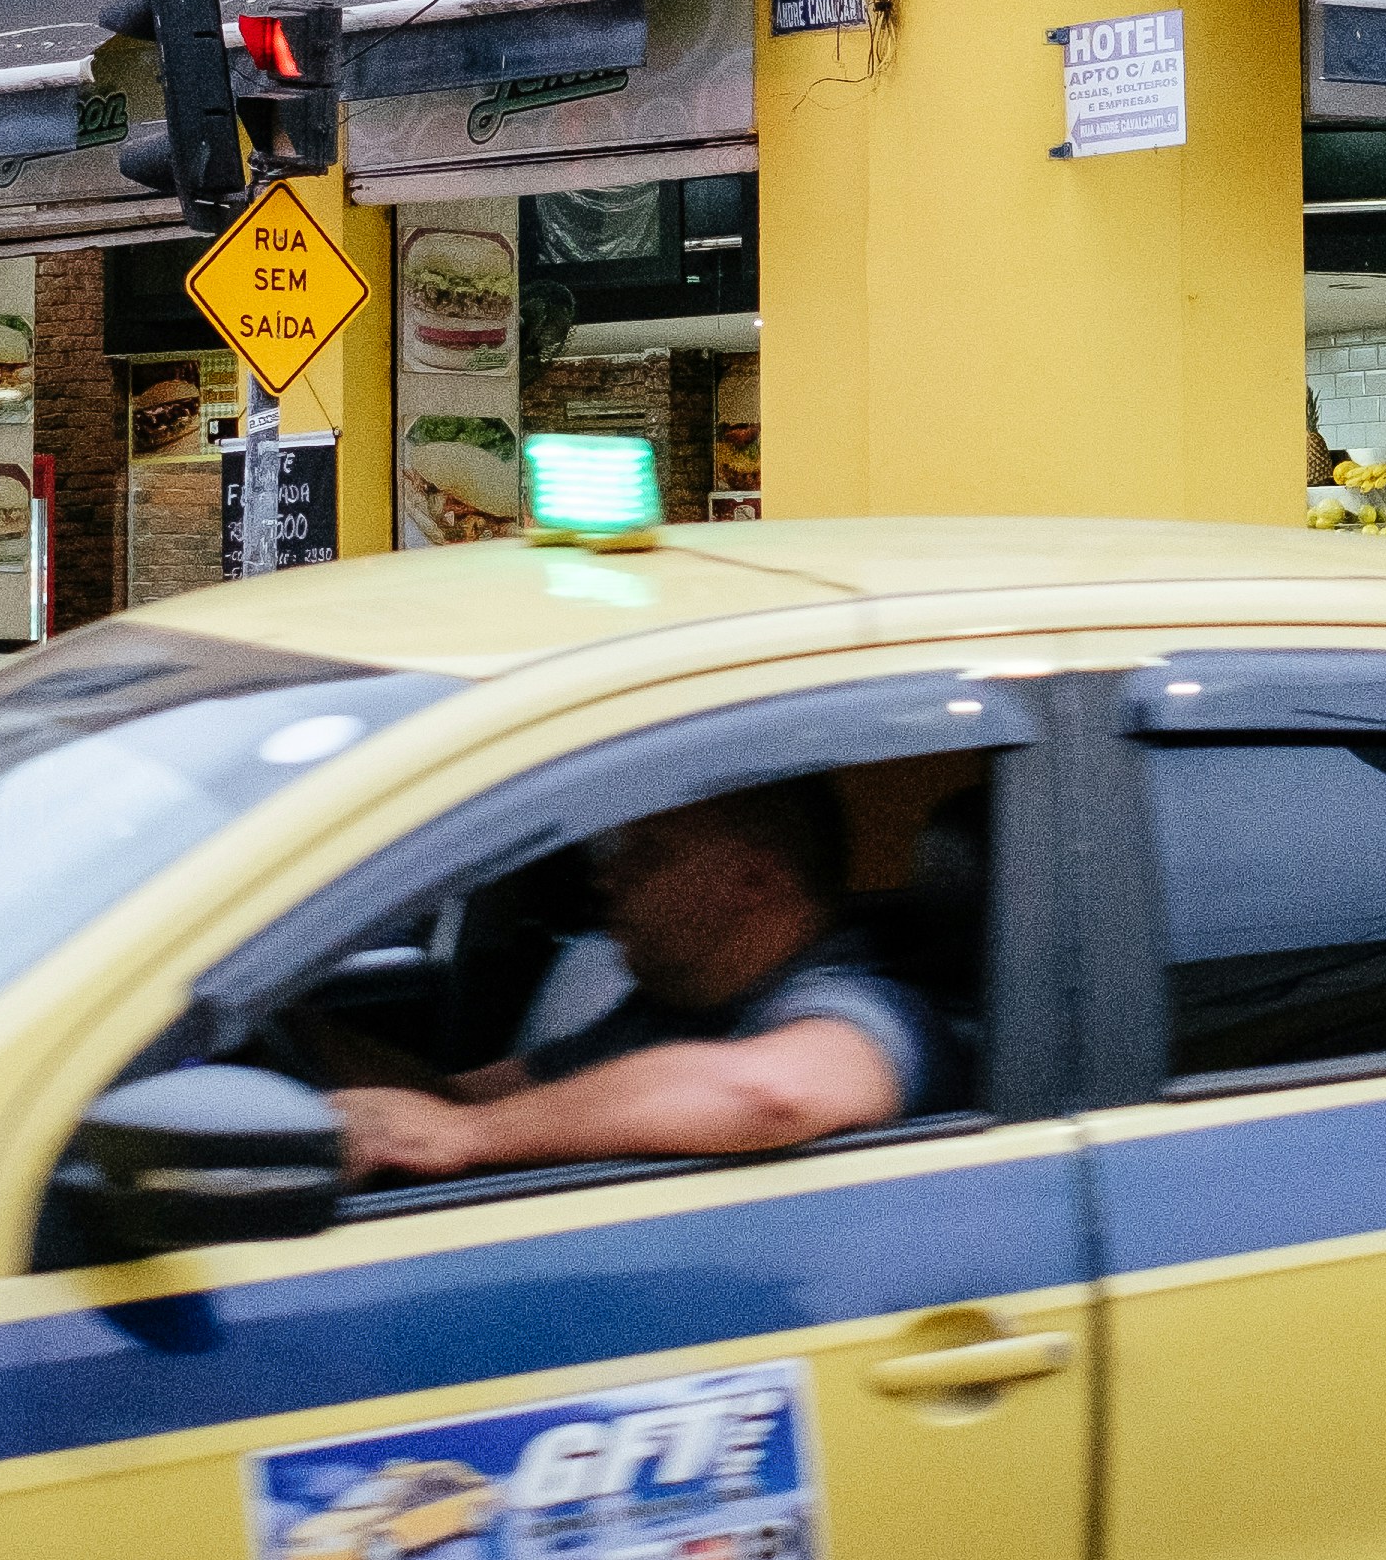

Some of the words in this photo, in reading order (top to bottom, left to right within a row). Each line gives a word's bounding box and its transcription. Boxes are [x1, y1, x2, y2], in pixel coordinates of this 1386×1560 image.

[1068, 15, 1176, 64] HOTEL
[1068, 65, 1120, 87] APTO
[1126, 60, 1146, 79] C/
[1151, 57, 1178, 75] AR
[1068, 85, 1113, 102] CASAIS,
[1116, 76, 1179, 94] SOLTEIROS
[1088, 102, 1095, 112] E
[1098, 93, 1159, 111] EMPRESAS
[1080, 123, 1095, 138] RUA
[254, 227, 308, 253] RUA
[254, 267, 307, 292] SEM
[239, 310, 317, 340] SAÍDA
